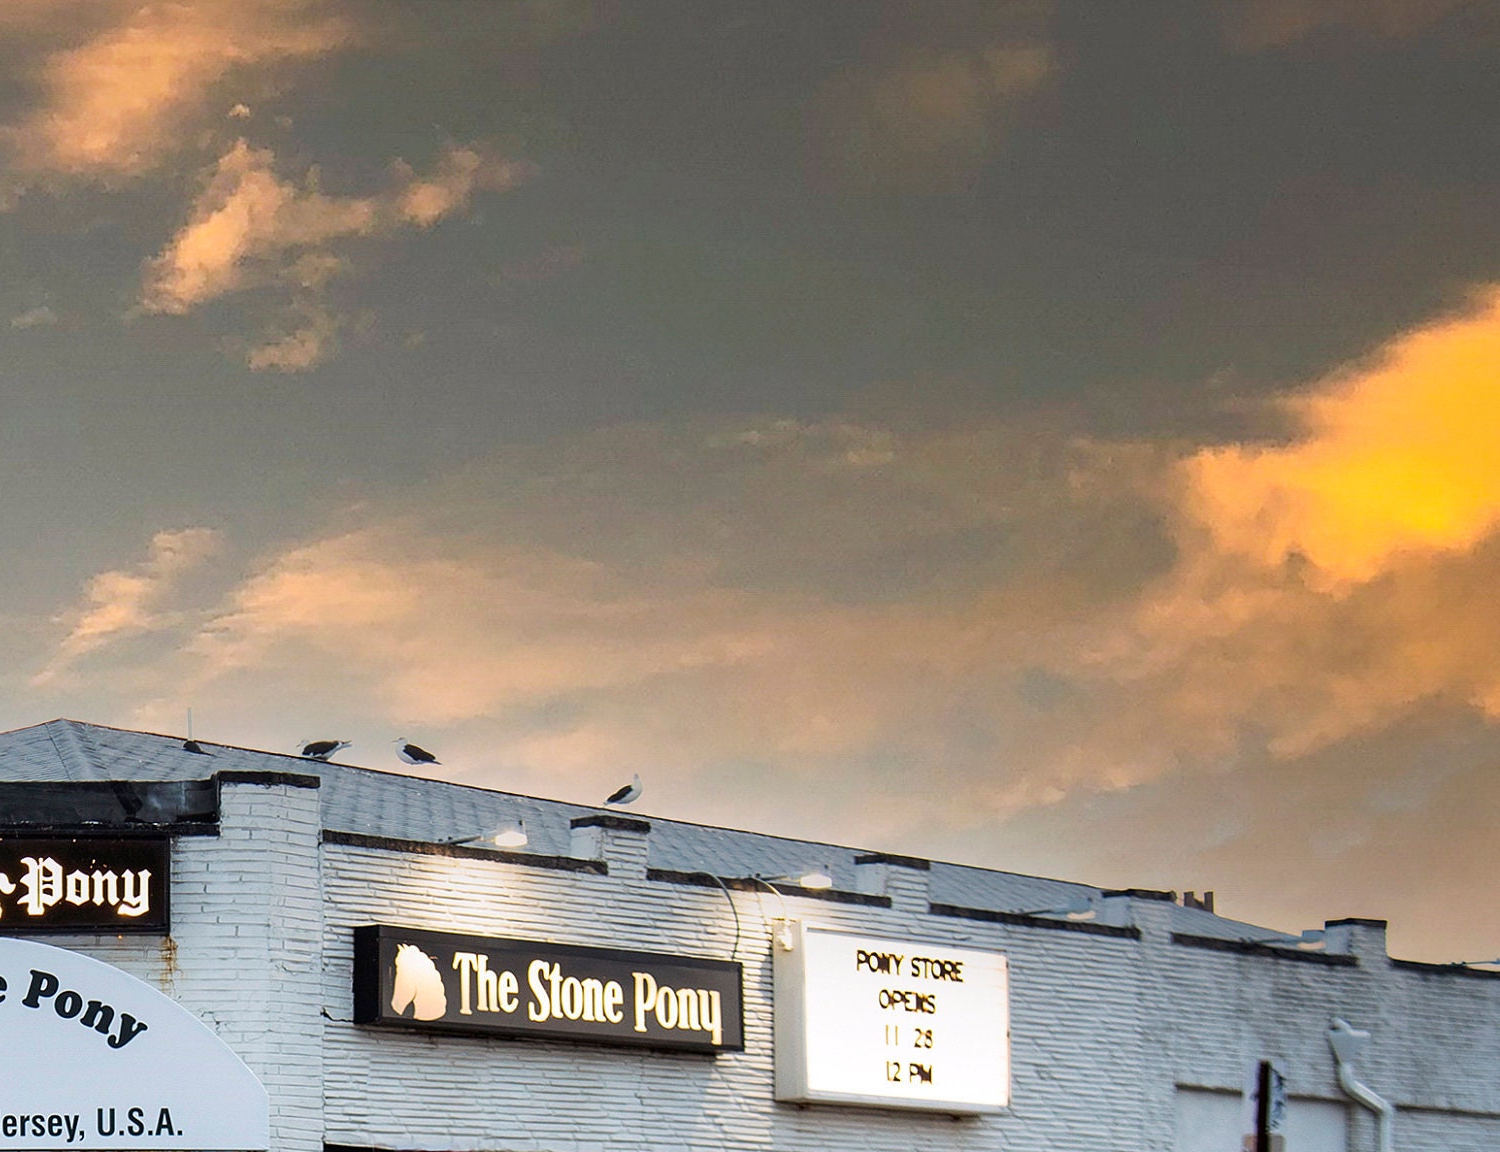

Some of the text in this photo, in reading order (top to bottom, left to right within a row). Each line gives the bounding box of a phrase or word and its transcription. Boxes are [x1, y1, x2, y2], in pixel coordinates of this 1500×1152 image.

[18, 856, 151, 917] Pony
[856, 949, 964, 983] PONY STORE
[21, 968, 149, 1050] Pony
[453, 951, 723, 1046] The Stone Pony
[878, 988, 937, 1015] OPENS
[913, 1027, 934, 1049] 28
[886, 1060, 934, 1086] 12 PM
[96, 1107, 184, 1137] U.S.A.
